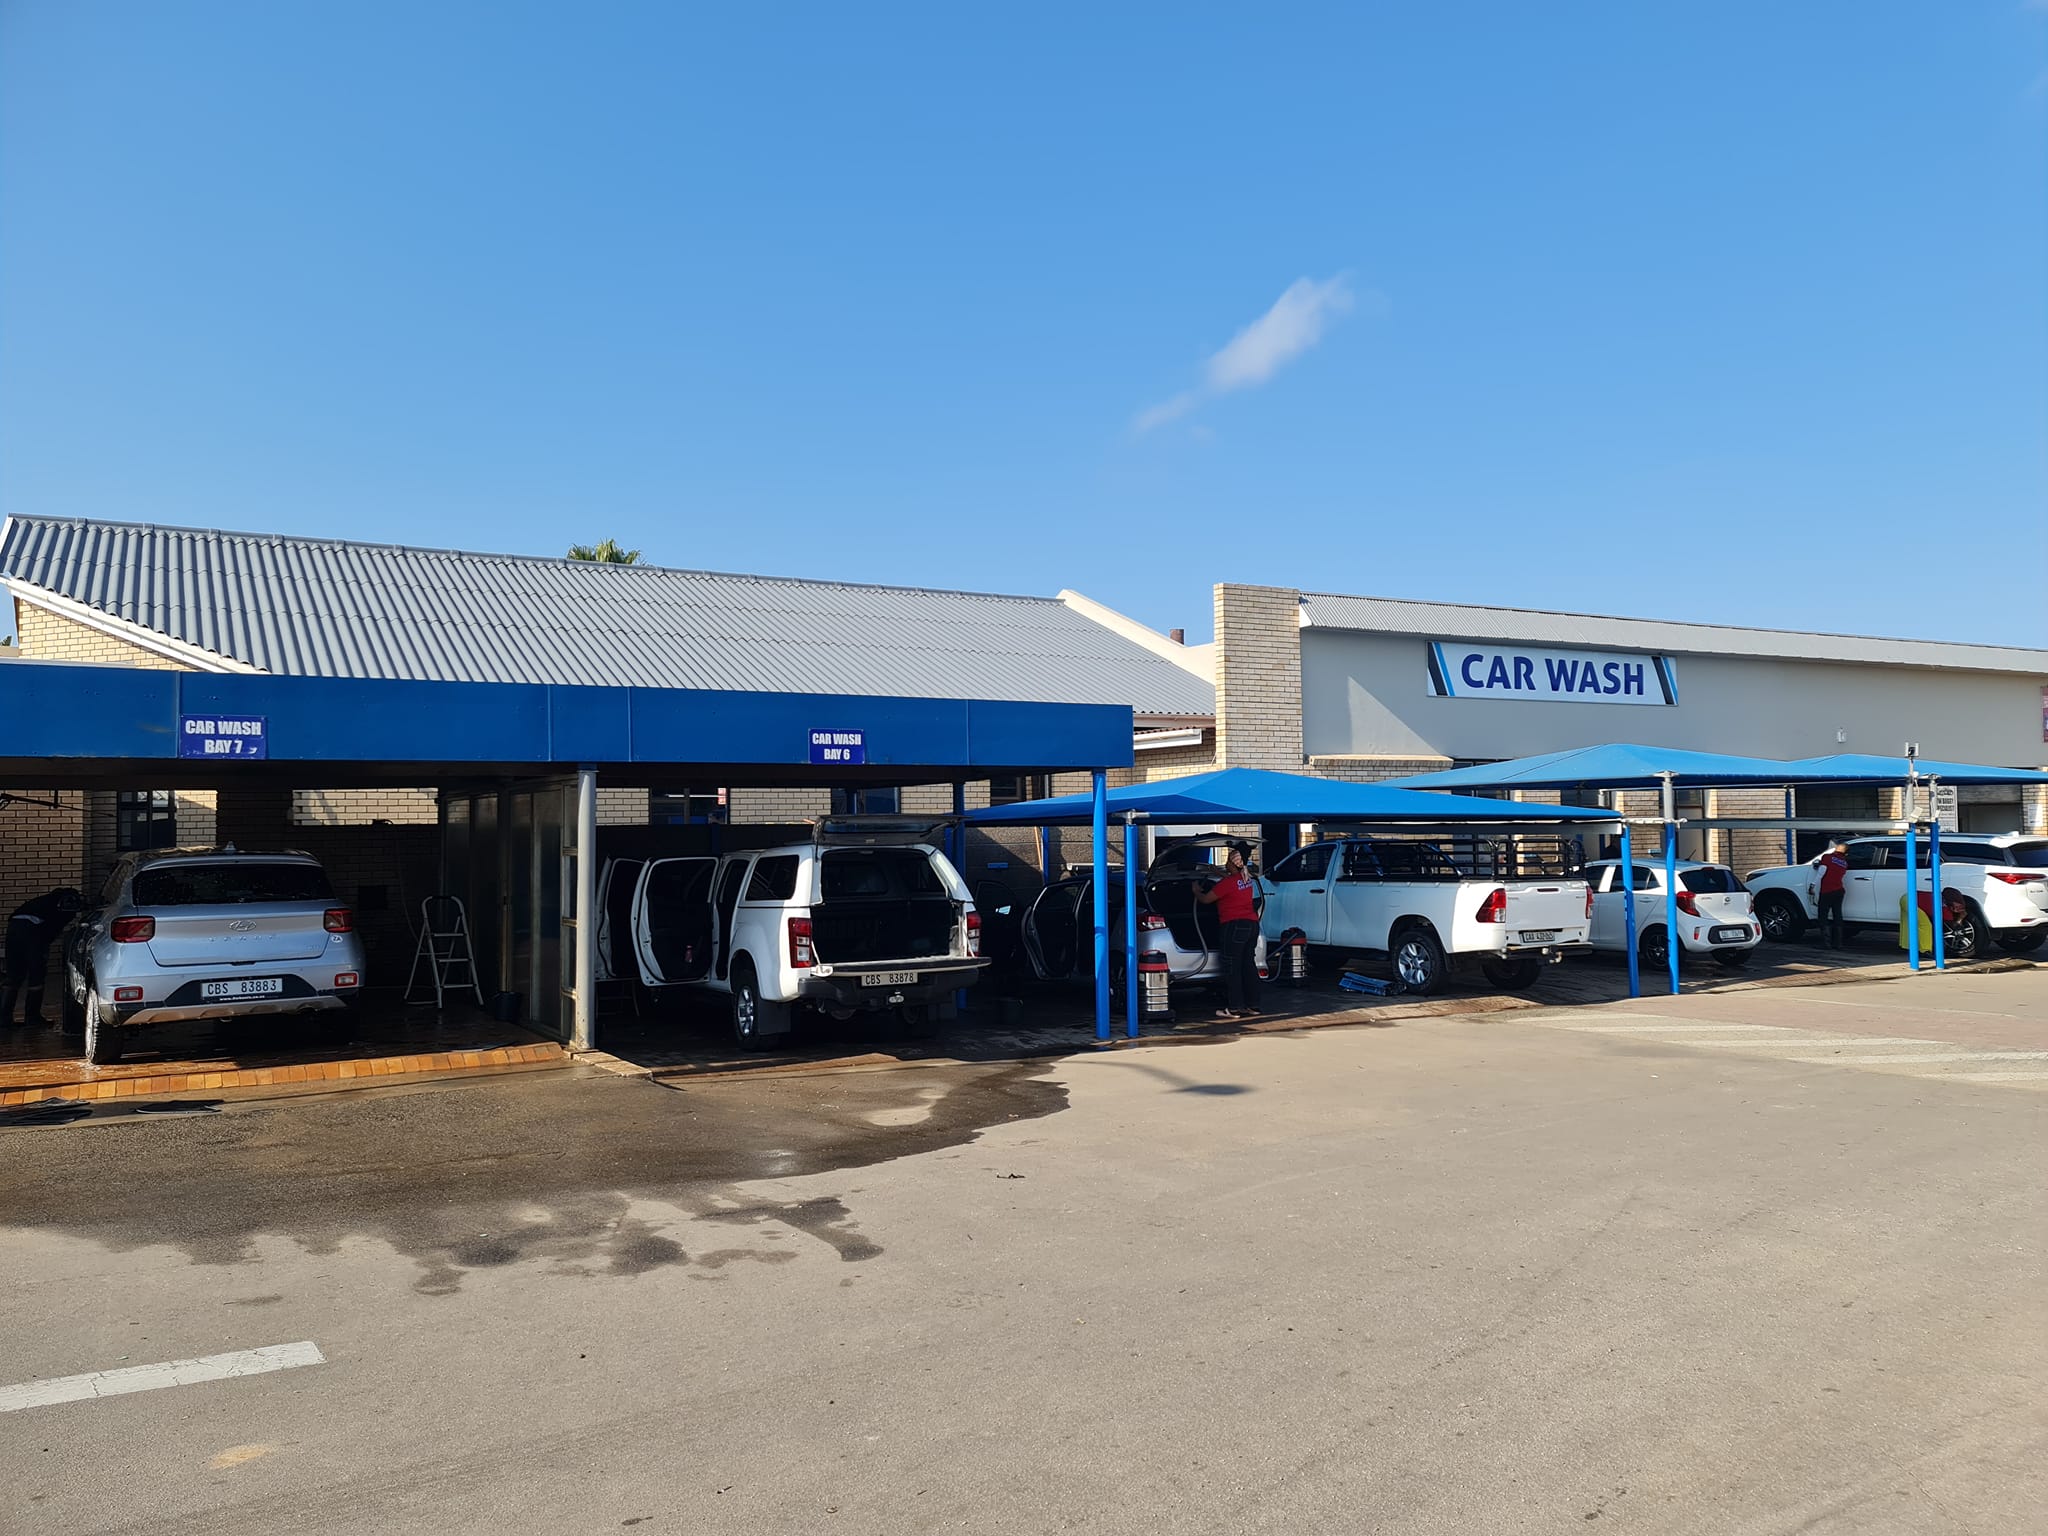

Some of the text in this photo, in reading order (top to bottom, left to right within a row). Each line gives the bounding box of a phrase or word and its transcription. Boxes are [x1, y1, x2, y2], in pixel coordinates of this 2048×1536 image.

[1461, 653, 1645, 696] CAR WASH
[185, 719, 262, 736] CAR WASH
[204, 739, 243, 755] BAY 7
[812, 732, 862, 746] CAR WASH
[823, 748, 851, 760] BAY 6
[207, 979, 277, 995] CBS 83883
[865, 974, 881, 985] CBS
